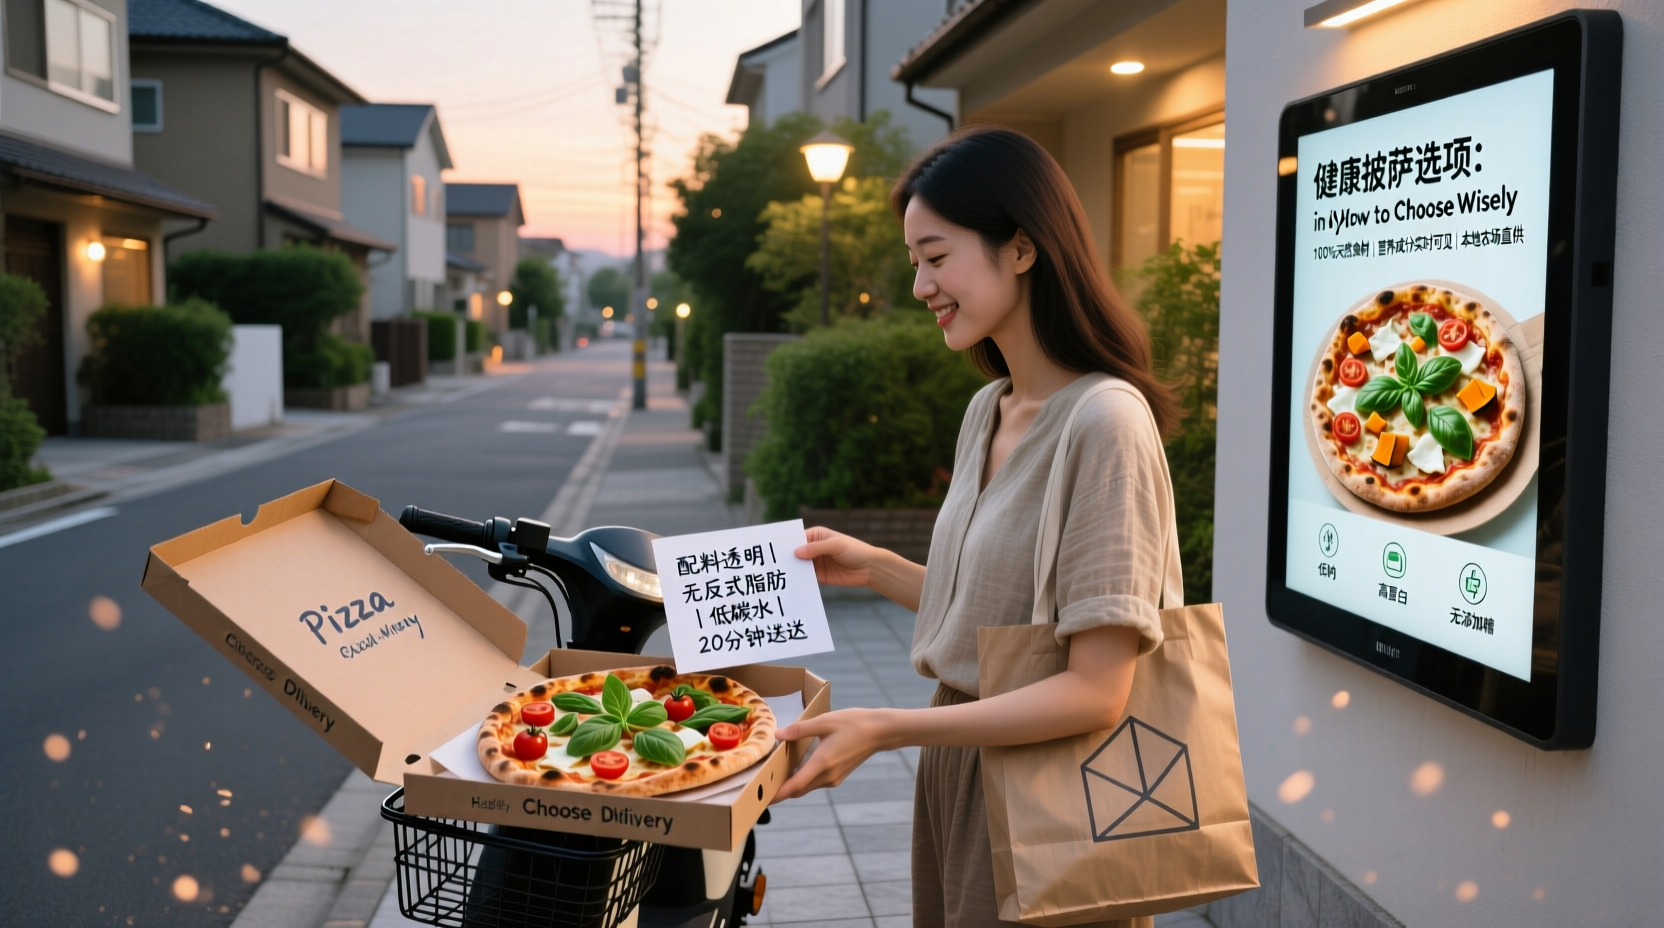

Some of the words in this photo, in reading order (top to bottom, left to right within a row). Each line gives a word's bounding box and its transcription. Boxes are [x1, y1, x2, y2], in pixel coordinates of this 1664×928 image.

[1374, 205, 1390, 224] to
[1394, 198, 1454, 221] Choose
[1457, 185, 1518, 216] Wisely
[682, 569, 786, 603] 无反式脂肪
[299, 591, 395, 645] Pizza
[522, 798, 592, 821] Choose
